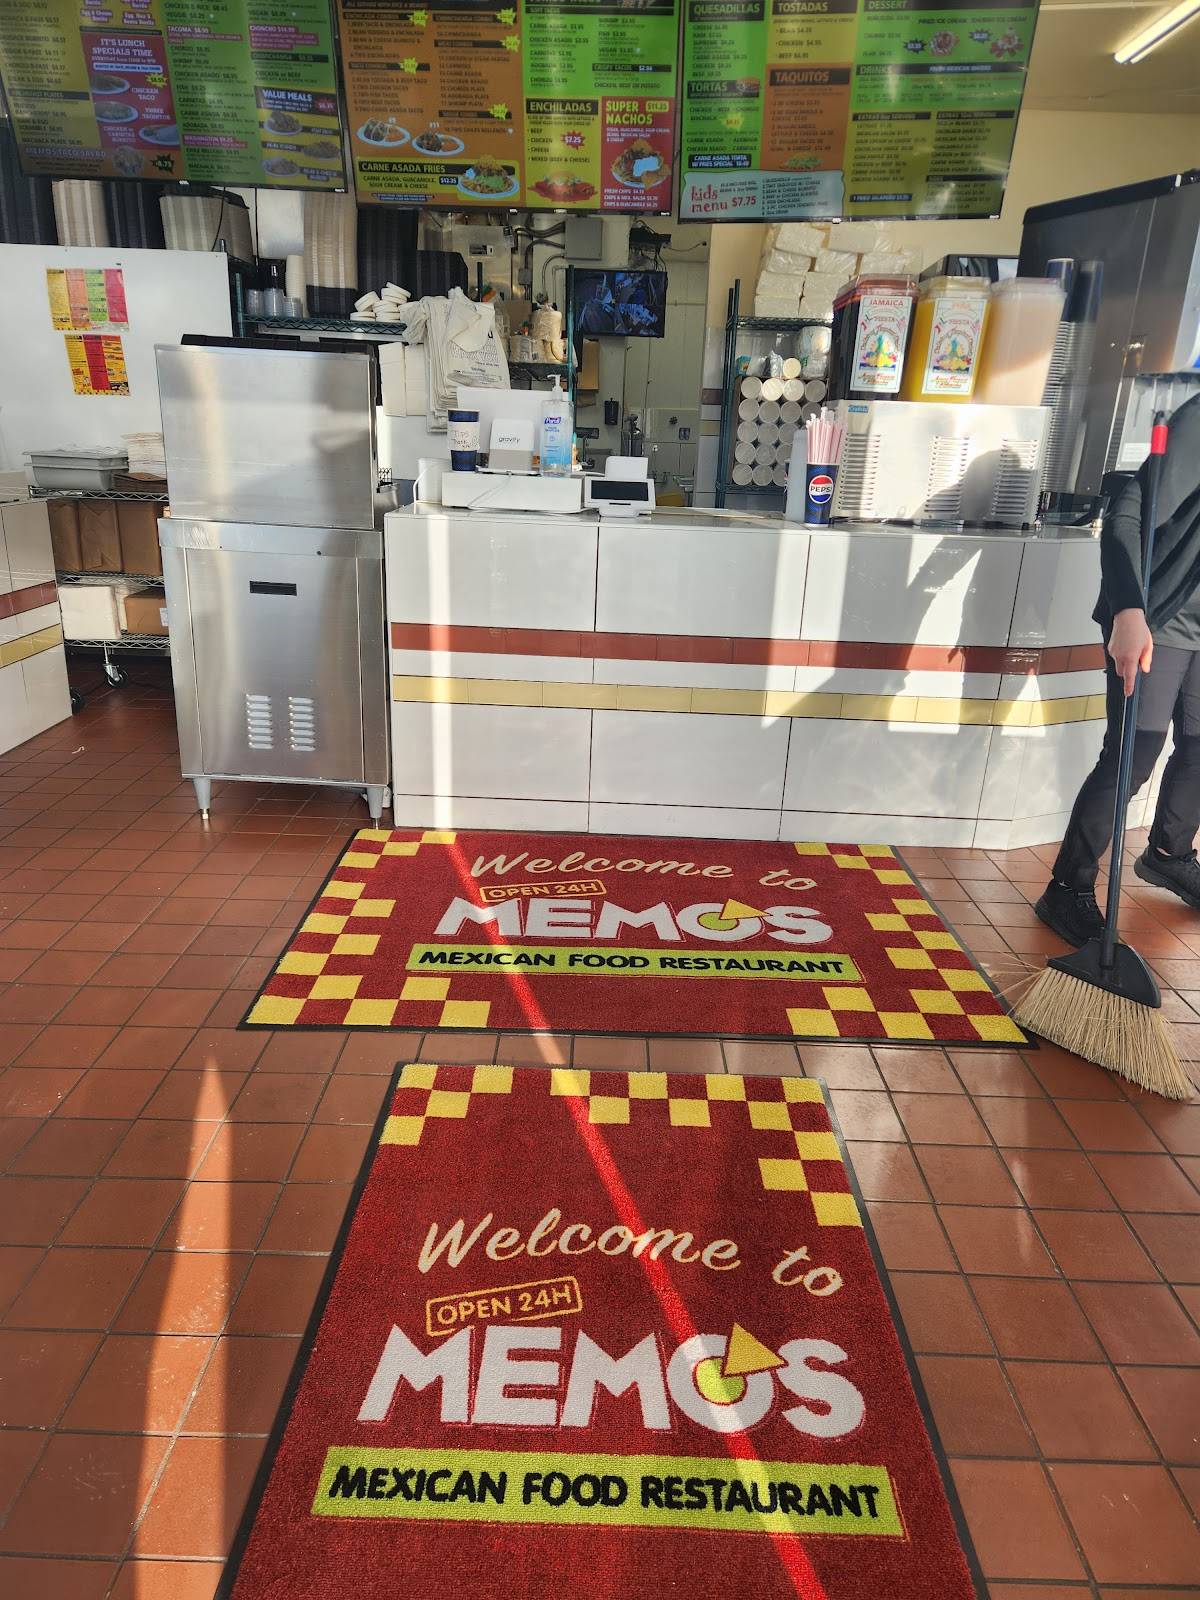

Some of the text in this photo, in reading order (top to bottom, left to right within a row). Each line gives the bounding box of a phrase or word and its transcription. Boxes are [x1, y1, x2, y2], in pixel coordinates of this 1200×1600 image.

[694, 4, 760, 16] QUESADILLAS
[778, 2, 828, 12] TOSTADAS
[92, 48, 153, 56] SPECIALS TIME
[776, 72, 830, 84] TAQUITOS
[691, 82, 728, 92] TORTAS
[262, 89, 313, 102] VALUE MEALS
[530, 102, 592, 112] ENCHILADAS
[606, 100, 638, 112] SUPER
[606, 114, 652, 124] NACHOS
[362, 162, 446, 173] CARNE ASADA FRIES
[691, 184, 718, 202] kids
[692, 201, 728, 214] menu
[732, 196, 756, 208] $7.75
[471, 852, 819, 891] Welcome to
[488, 882, 599, 899] OPEN 24H
[417, 951, 845, 974] MEXICAN FOOD RESTAURANT
[417, 1207, 844, 1297] Welcome to
[437, 1285, 574, 1327] OPEN 24H
[328, 1465, 880, 1520] MEXICAN FOOD RESTAURANT
